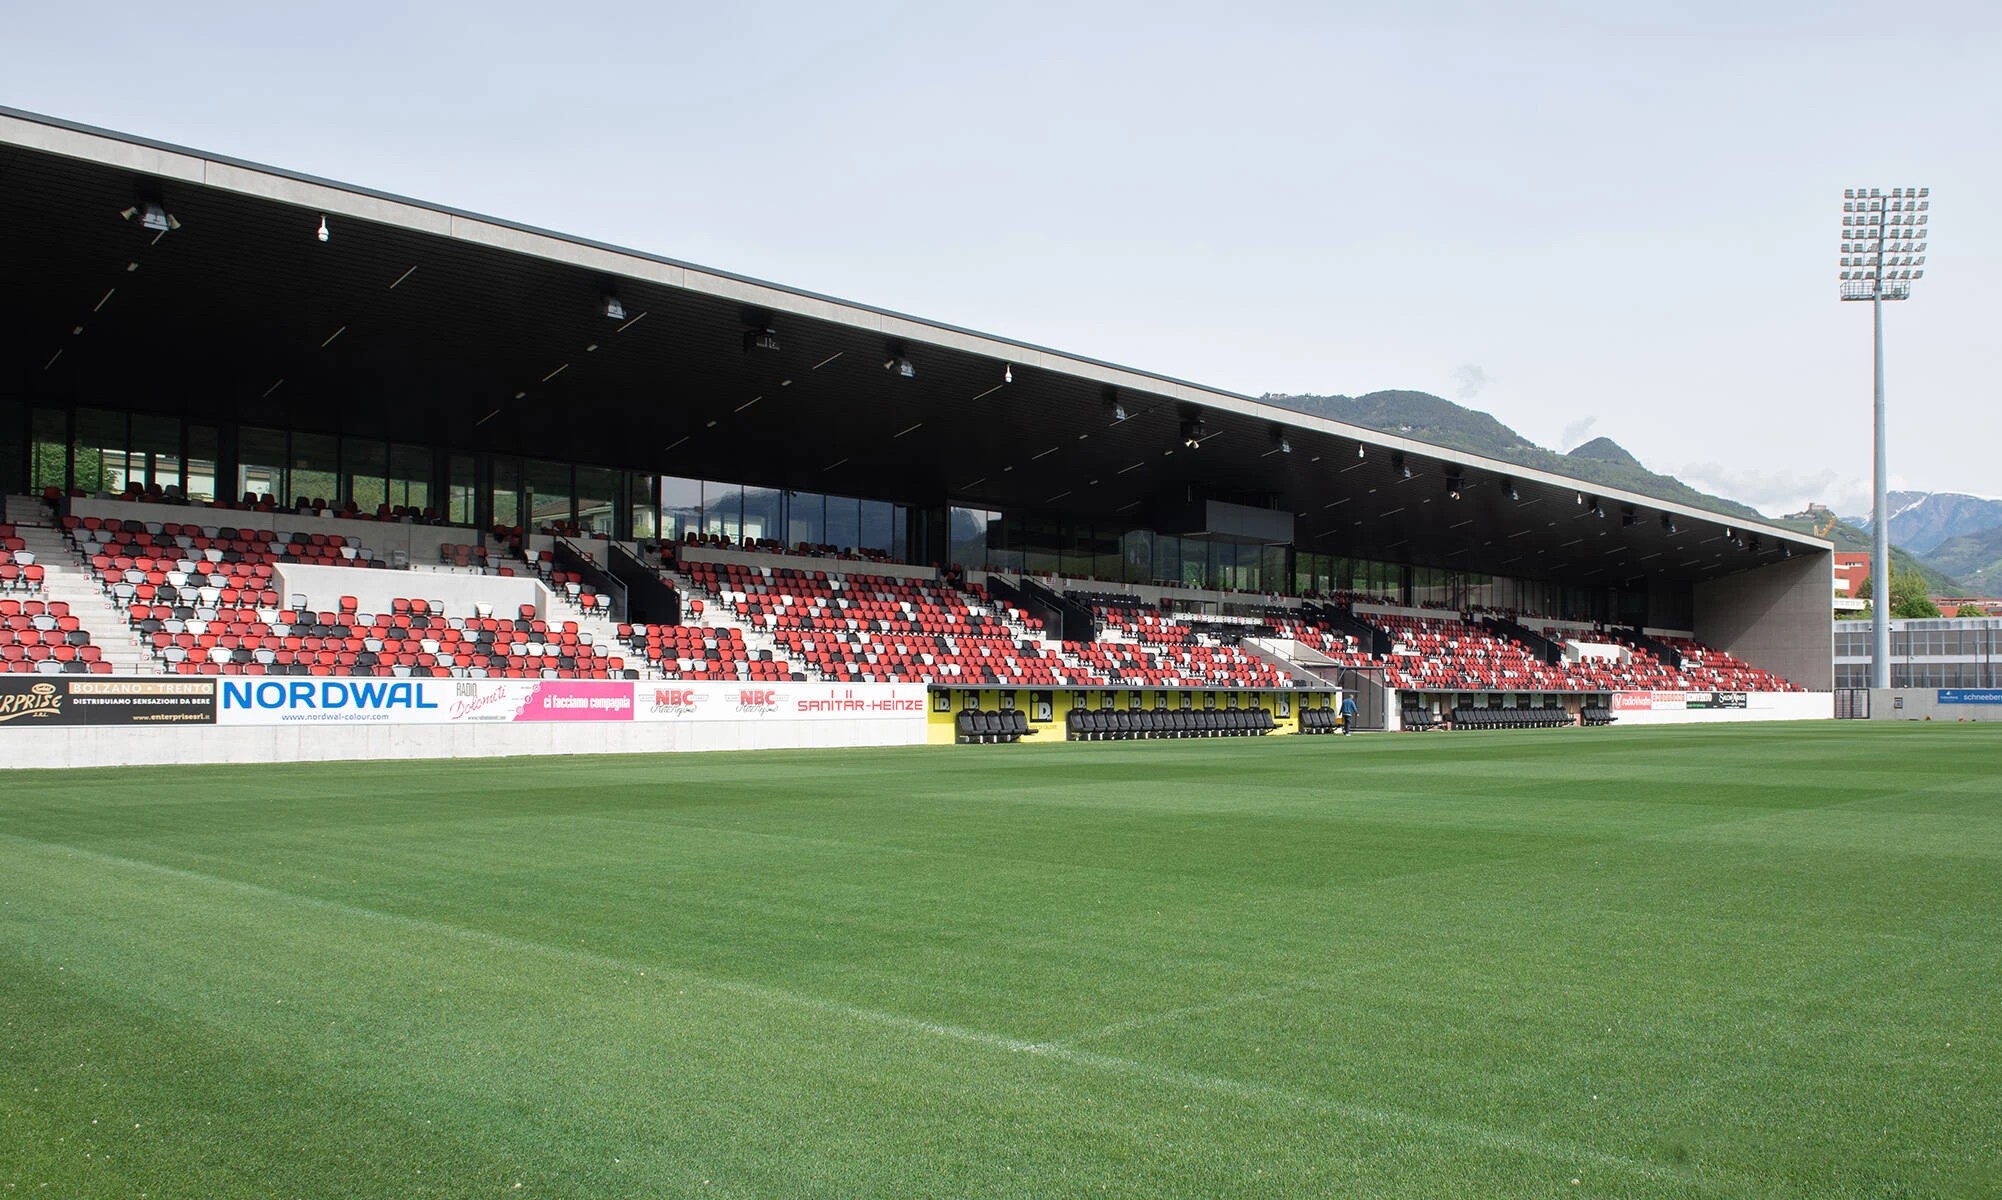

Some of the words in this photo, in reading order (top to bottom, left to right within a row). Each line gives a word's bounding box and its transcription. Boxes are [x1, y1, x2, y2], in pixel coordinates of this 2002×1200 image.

[74, 684, 142, 693] BOLZANO
[158, 684, 212, 693] TRENTO
[223, 681, 439, 709] NORDWAL
[456, 682, 478, 697] RADIO
[655, 689, 694, 706] NBC
[740, 689, 776, 706] NBC
[1963, 693, 2002, 701] schneeber
[281, 712, 390, 721] www.nordwal-colour.com
